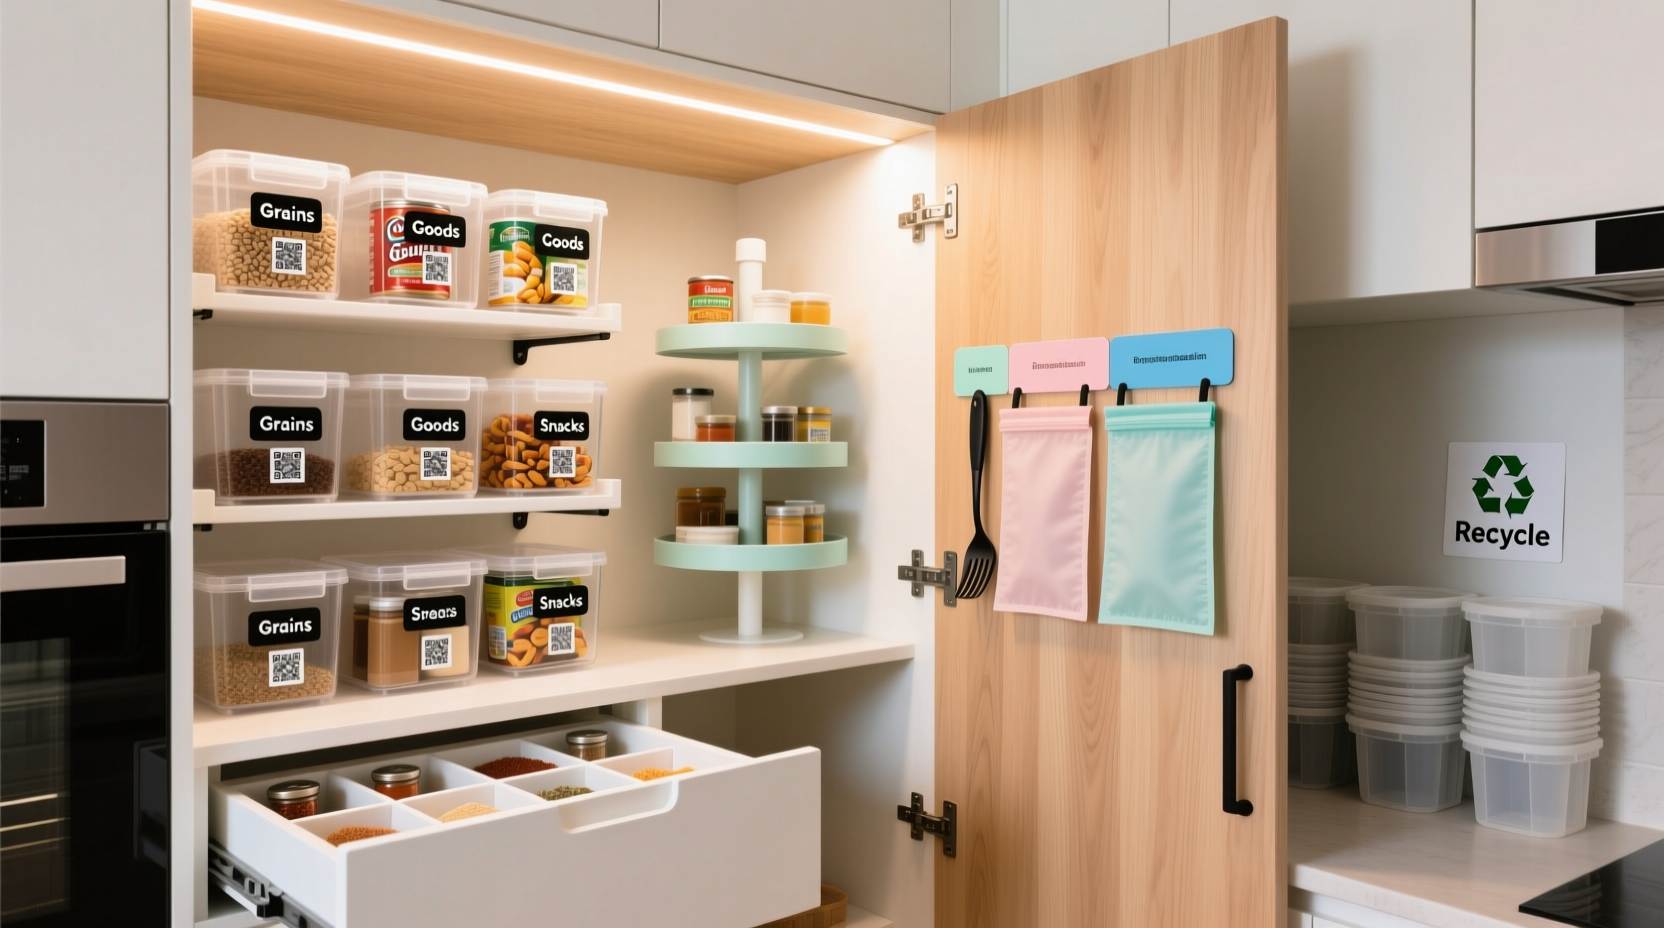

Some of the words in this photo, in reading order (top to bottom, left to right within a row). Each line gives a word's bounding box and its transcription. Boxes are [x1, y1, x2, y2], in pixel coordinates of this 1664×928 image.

[259, 202, 315, 224] Grains
[411, 219, 460, 239] Goods
[259, 415, 314, 432] Grains
[411, 416, 460, 432] Goods
[540, 417, 585, 433] Snacks
[1455, 520, 1550, 551] Recycle
[540, 593, 583, 610] Snacks
[258, 617, 313, 636] Grains
